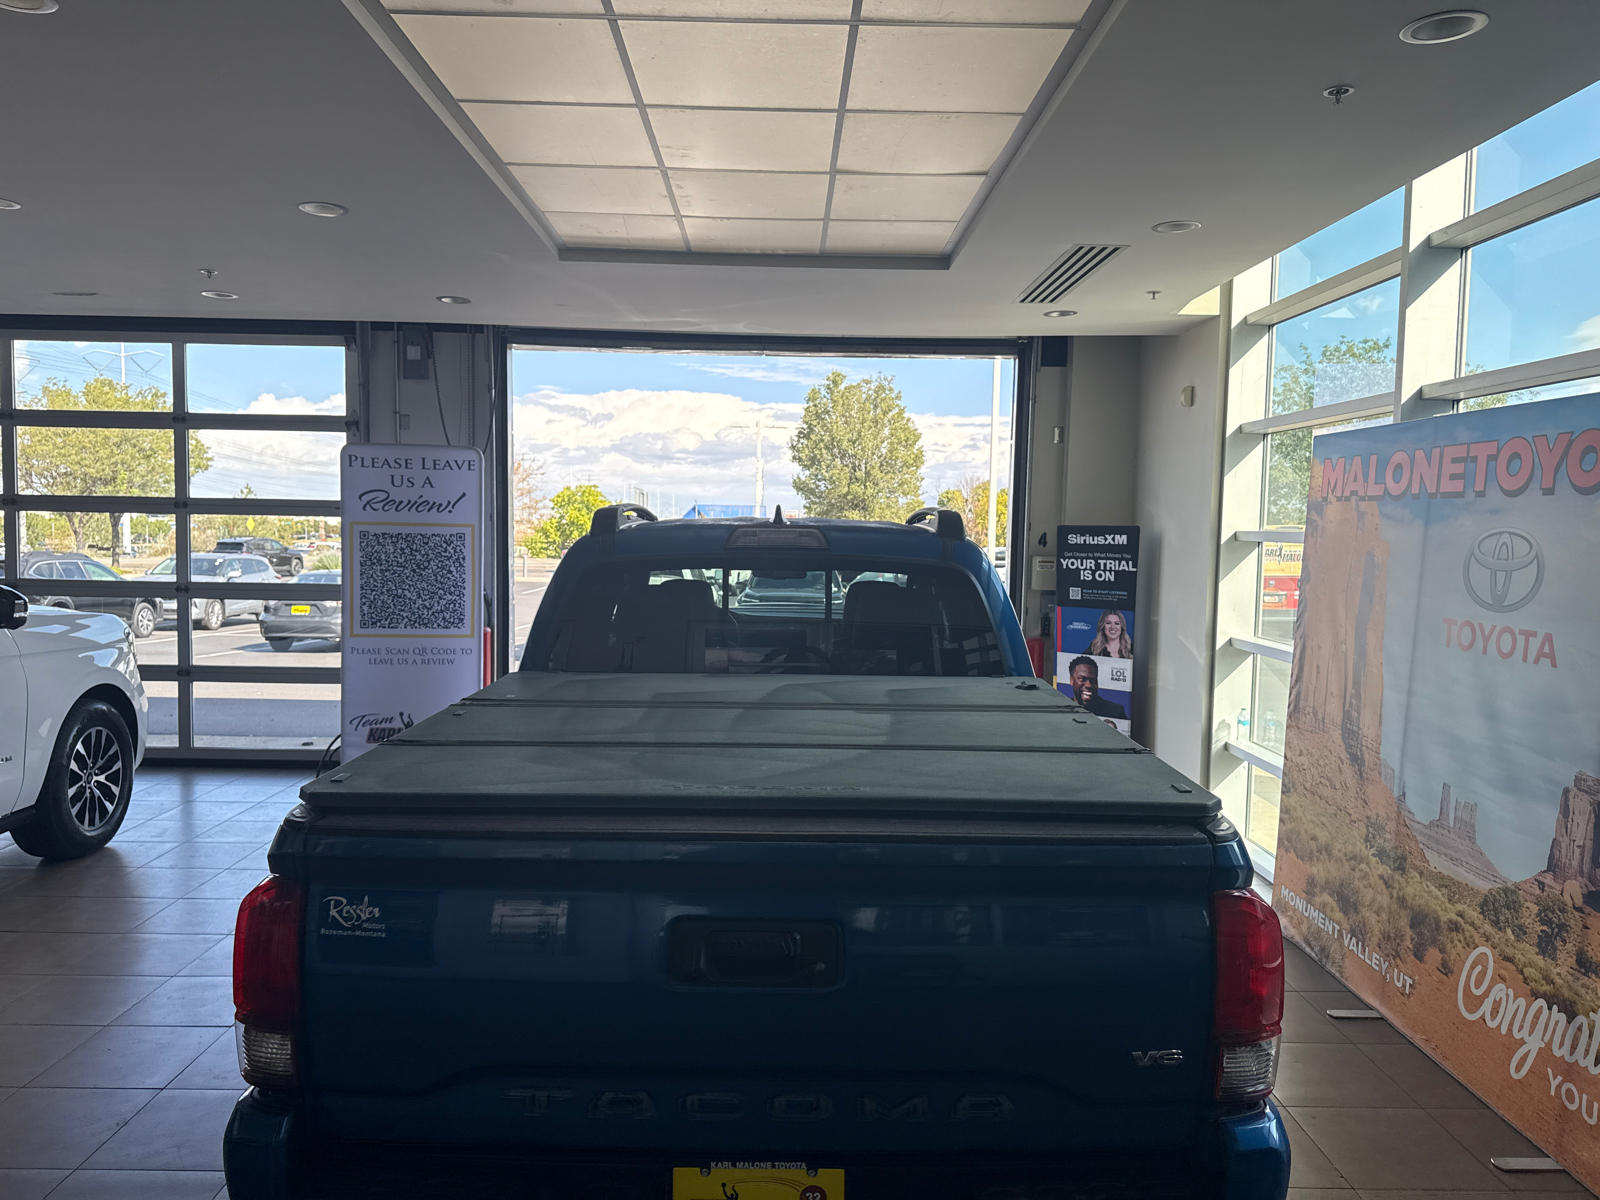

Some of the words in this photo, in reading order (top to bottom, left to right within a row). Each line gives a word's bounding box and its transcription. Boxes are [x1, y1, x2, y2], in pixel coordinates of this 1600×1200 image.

[420, 476, 436, 488] A
[358, 489, 467, 514] Review!
[1038, 532, 1048, 548] 4
[1068, 534, 1128, 545] SiriusXM
[1060, 558, 1096, 570] YOUR
[1098, 560, 1137, 571] TRIAL
[1282, 553, 1302, 562] MALO
[1080, 570, 1092, 580] IS
[1095, 570, 1115, 581] ON
[1443, 617, 1558, 668] TOYOTA
[412, 647, 429, 657] QR
[1111, 670, 1126, 678] LOL
[350, 712, 396, 732] Team
[368, 727, 404, 742] KAR
[1280, 885, 1340, 939] MONUMENT
[1342, 933, 1390, 983] VALLEY,
[1392, 970, 1414, 994] UT
[1131, 1049, 1184, 1068] V6
[500, 1088, 1016, 1122] TACOMA
[710, 1161, 734, 1169] KARL
[736, 1162, 773, 1170] MALONE
[774, 1162, 807, 1170] TOYOTA
